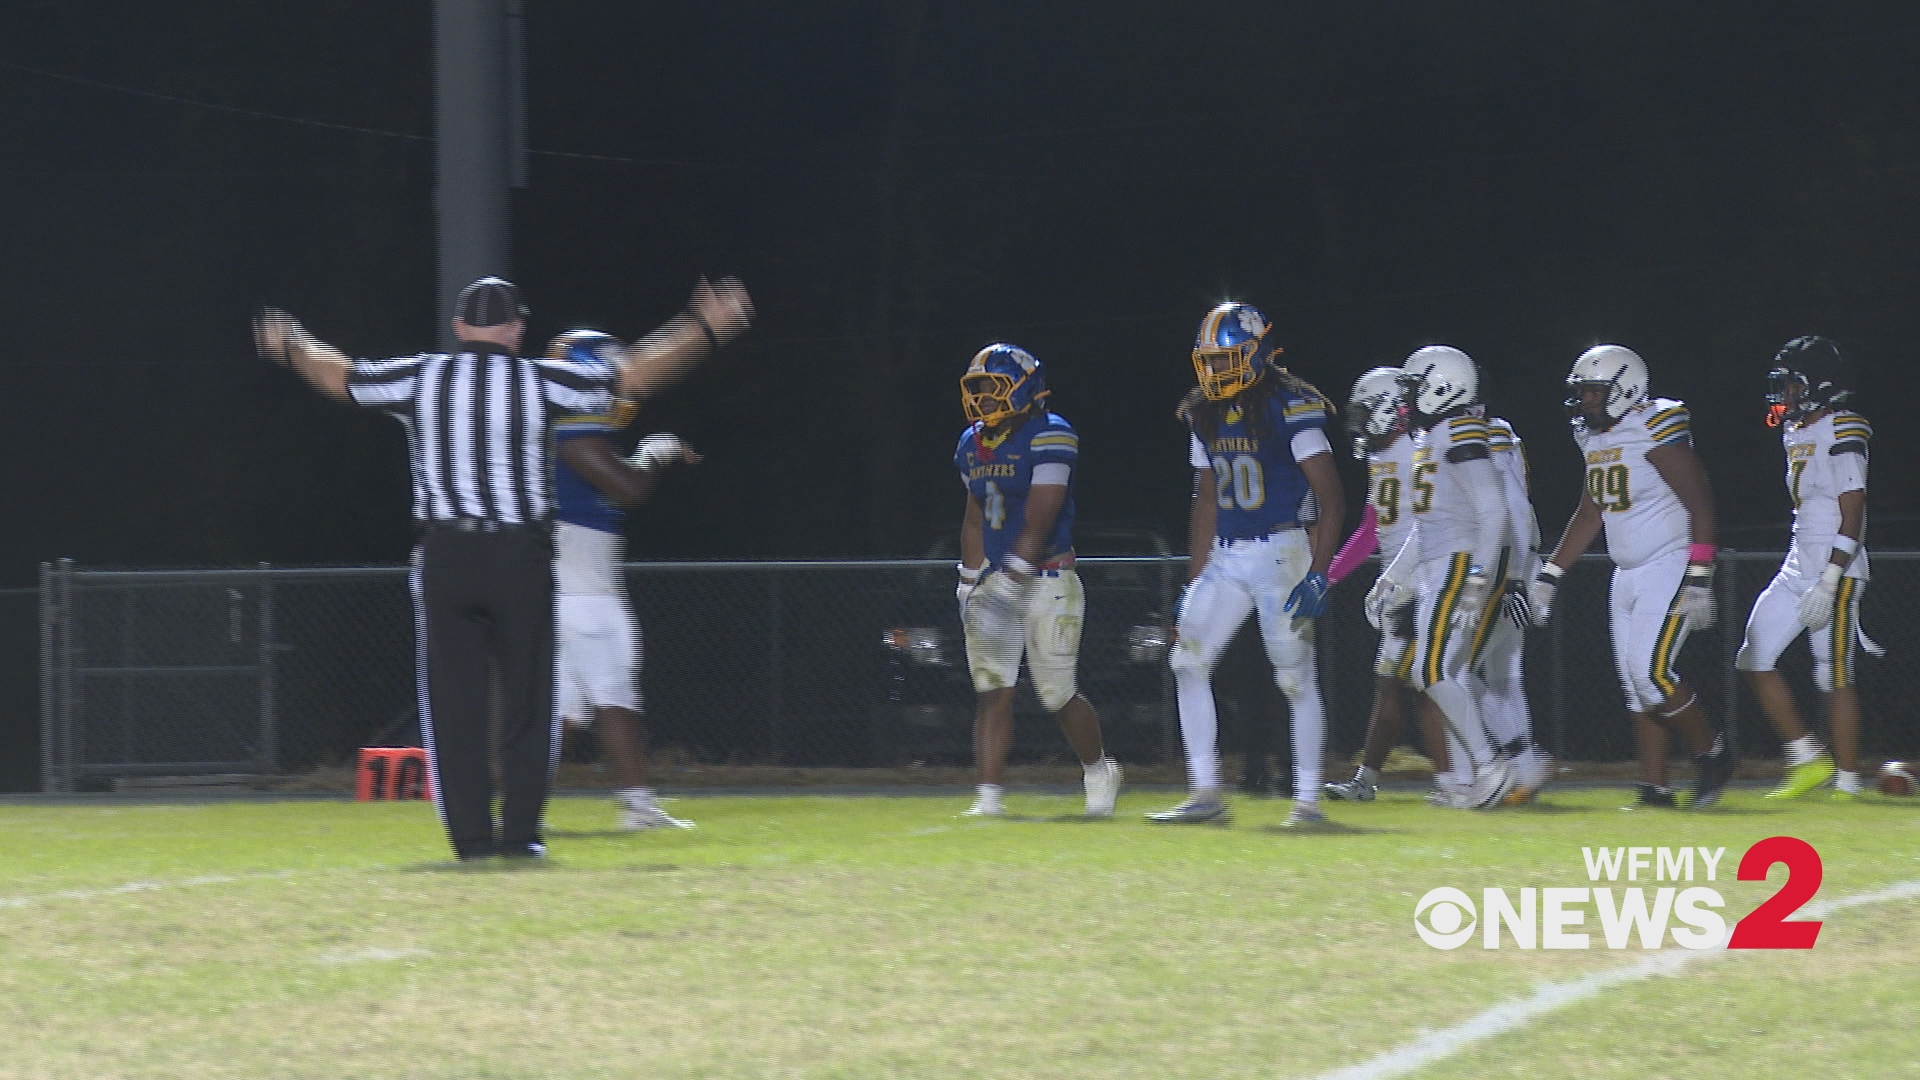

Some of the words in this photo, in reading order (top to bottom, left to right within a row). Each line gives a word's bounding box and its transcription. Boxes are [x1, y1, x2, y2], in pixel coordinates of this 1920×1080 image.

[1208, 438, 1258, 452] ANTHERS
[969, 463, 1016, 480] PANTHERS
[1212, 454, 1266, 511] 20
[1412, 462, 1438, 514] 5
[1587, 463, 1633, 513] 99
[984, 480, 1006, 530] 4
[366, 755, 426, 801] 10
